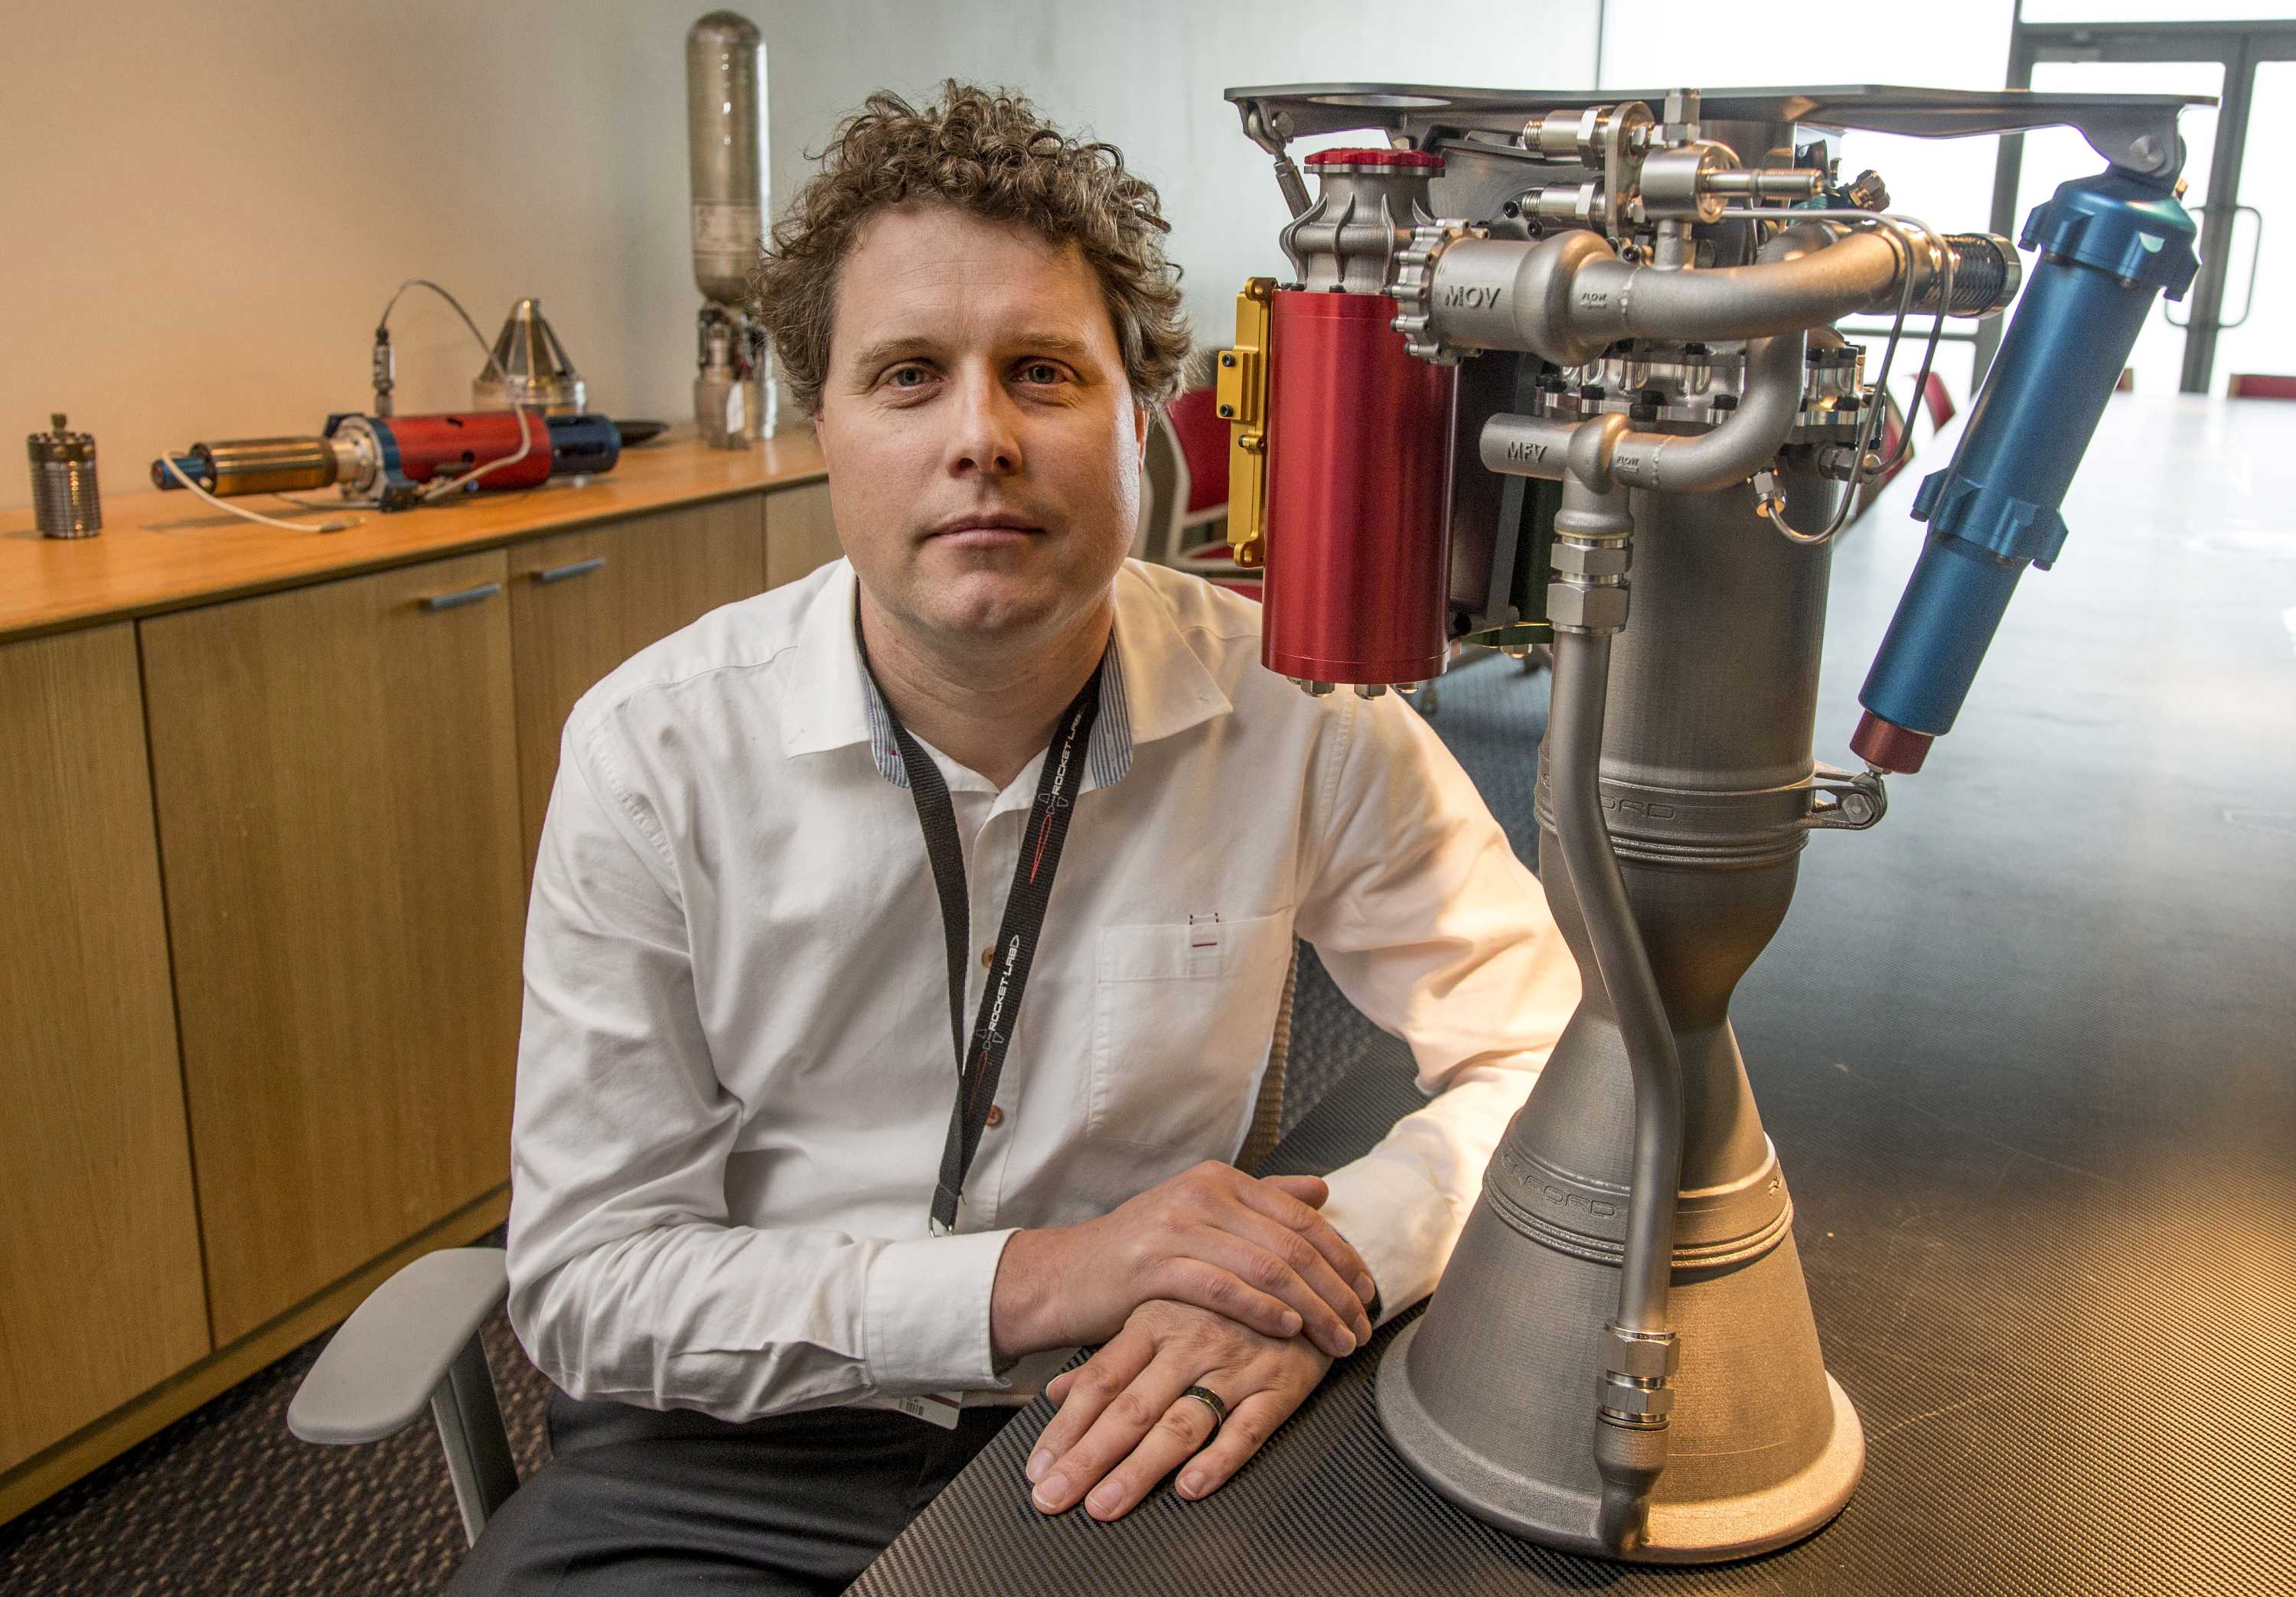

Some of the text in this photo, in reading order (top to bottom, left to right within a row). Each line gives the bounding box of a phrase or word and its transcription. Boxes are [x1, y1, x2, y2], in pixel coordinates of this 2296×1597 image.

[1444, 285, 1501, 308] MOV
[1506, 442, 1548, 463] MFV
[1052, 740, 1071, 796] ROCKET
[988, 976, 1009, 1032] ROCKET
